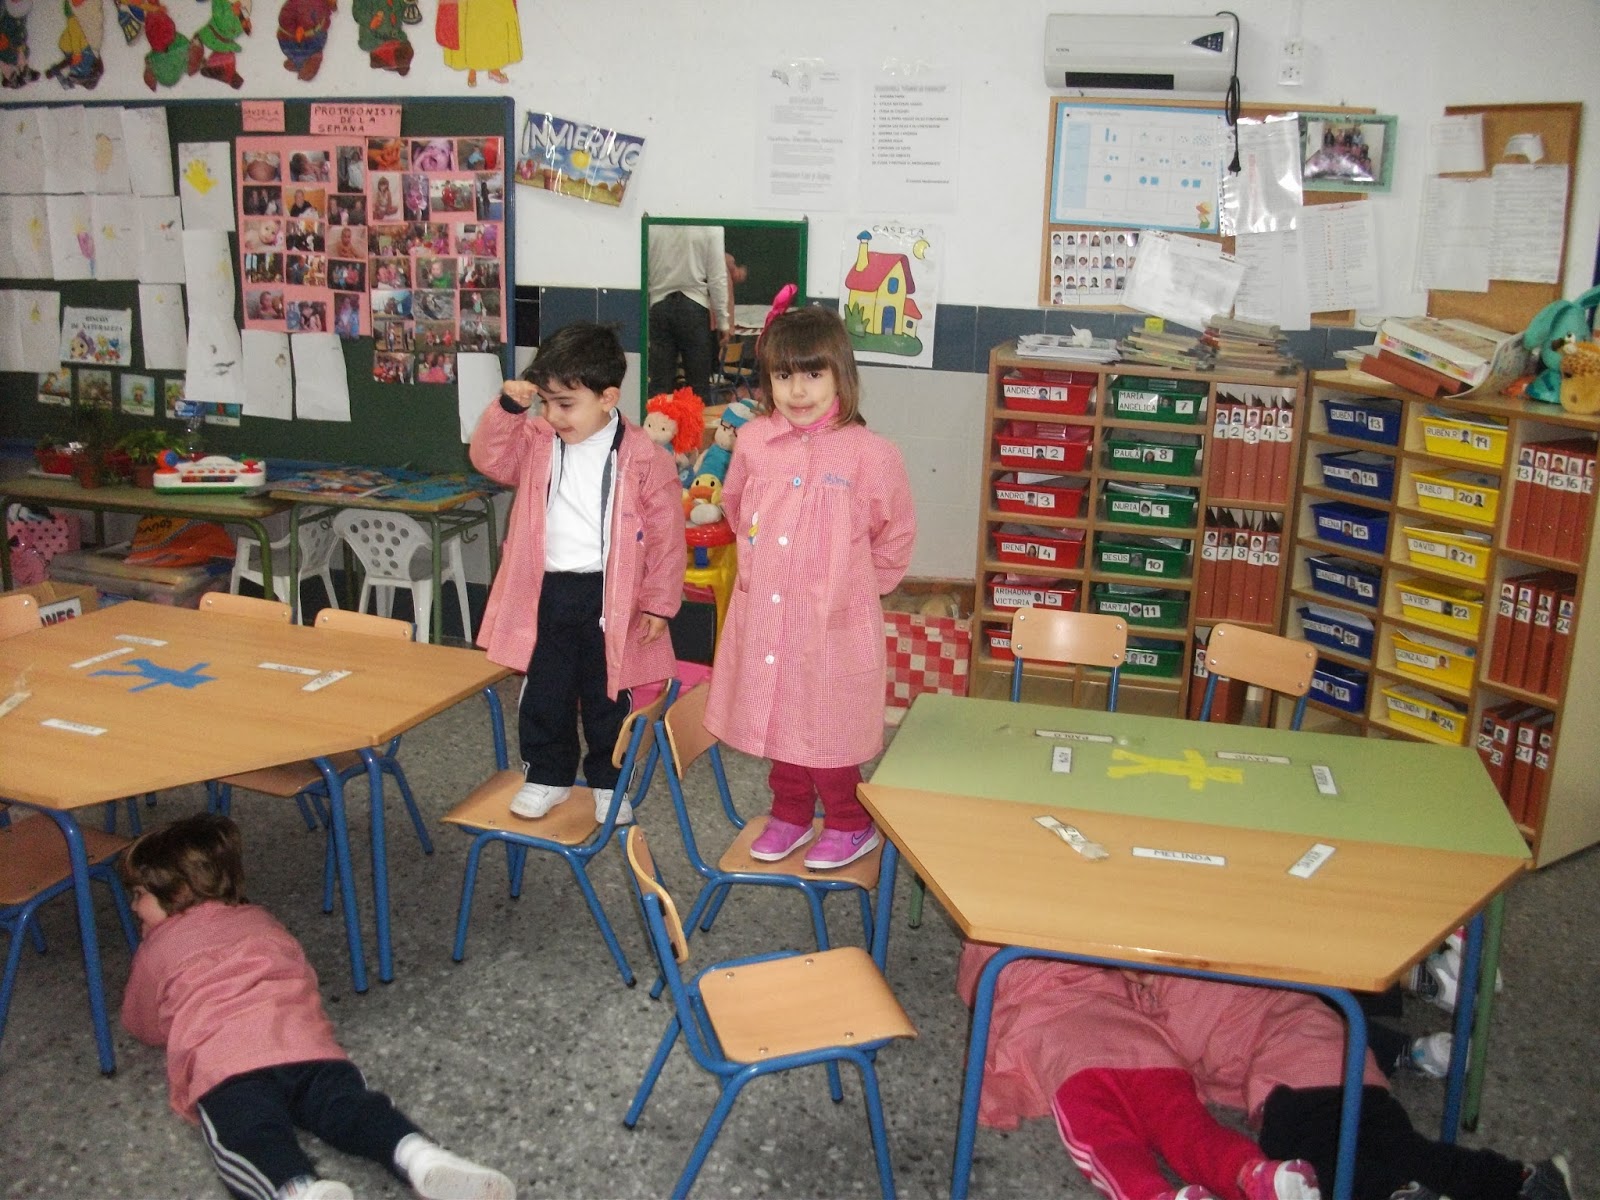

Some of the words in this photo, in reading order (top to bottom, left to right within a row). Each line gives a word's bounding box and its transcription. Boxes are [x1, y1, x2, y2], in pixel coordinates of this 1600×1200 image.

[314, 105, 402, 116] PROTAGONISTA
[317, 124, 366, 133] SEMANA
[872, 225, 925, 236] CASITA
[1005, 385, 1037, 396] ANDRÉS
[1054, 391, 1063, 401] 1
[1180, 401, 1188, 411] 7
[1370, 418, 1381, 430] 13
[1218, 429, 1226, 438] 1
[1230, 426, 1239, 437] 2
[1246, 429, 1257, 442] 3
[1263, 428, 1272, 439] 4
[1278, 429, 1289, 440] 5
[1475, 436, 1488, 448] 19
[1001, 445, 1032, 456] RAFAEL
[1050, 448, 1059, 459] 2
[1114, 448, 1140, 458] PAULA
[1159, 449, 1168, 461] 8
[1363, 473, 1375, 485] 14
[1517, 467, 1530, 480] 13
[1533, 469, 1544, 483] 14
[1549, 474, 1564, 487] 15
[1566, 476, 1578, 489] 16
[1418, 483, 1442, 495] PABLO
[1458, 492, 1473, 503] 20
[1041, 495, 1050, 506] 3
[1113, 502, 1138, 511] NURIA
[1156, 505, 1164, 515] 9
[1354, 526, 1366, 537] 15
[1002, 543, 1024, 552] IRENE
[1042, 548, 1051, 559] 4
[1203, 547, 1212, 558] 6
[1220, 548, 1230, 558] 7
[1237, 548, 1246, 559] 8
[1413, 540, 1435, 552] DAVID
[1460, 552, 1474, 564] 21
[1252, 553, 1262, 564] 9
[1264, 552, 1278, 563] 10
[1147, 560, 1162, 570] 10
[1359, 583, 1370, 595] 16
[994, 597, 1030, 606] VICTORIA
[1047, 594, 1058, 604] 5
[1403, 593, 1430, 606] JAVIER
[1453, 606, 1468, 619] 22
[1100, 602, 1128, 612] MARTA
[1143, 606, 1158, 617] 11
[1516, 606, 1528, 621] 19
[1534, 610, 1549, 624] 20
[991, 638, 1011, 647] CAYE
[1141, 654, 1155, 665] 12
[1396, 650, 1430, 664] GONZALO
[1194, 665, 1206, 676] 11
[1335, 688, 1346, 699] 17
[1389, 697, 1420, 715] MELINDA
[1440, 717, 1454, 731] 24
[1153, 849, 1213, 863] MELINDA
